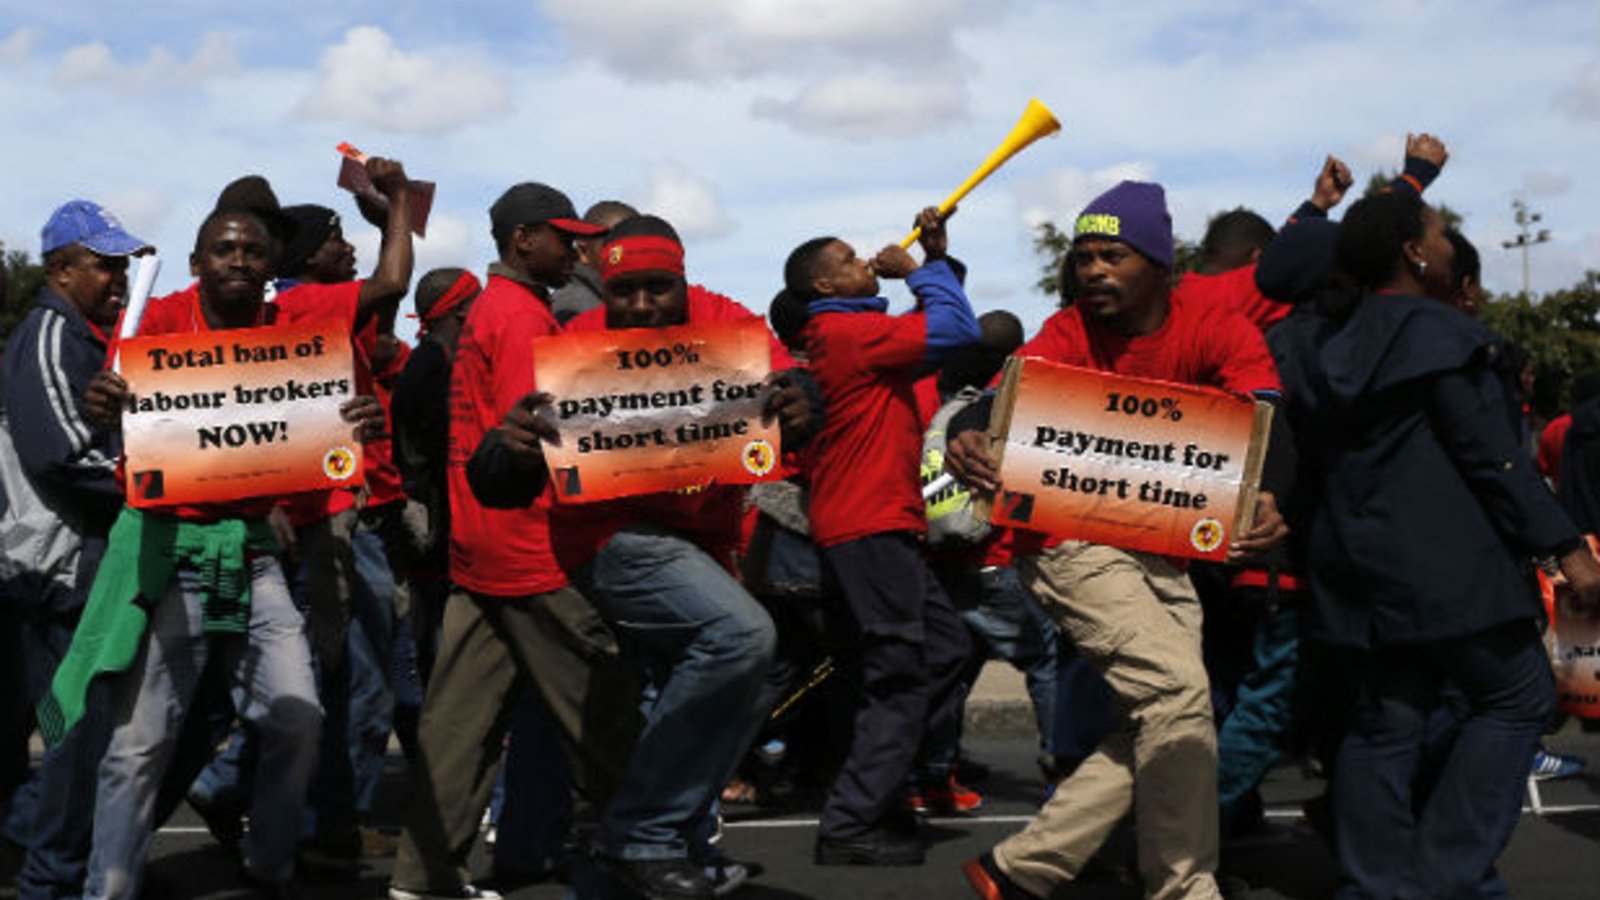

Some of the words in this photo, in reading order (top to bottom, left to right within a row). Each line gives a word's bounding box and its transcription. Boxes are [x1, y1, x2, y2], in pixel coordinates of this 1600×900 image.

[147, 345, 225, 370] Total
[233, 343, 288, 363] ban
[295, 335, 326, 358] of
[616, 343, 700, 370] 100%
[128, 390, 226, 414] labour
[233, 378, 349, 406] brokers
[558, 383, 704, 420] payment
[712, 379, 762, 402] for
[1105, 392, 1183, 422] 100%
[197, 420, 289, 450] NOW!
[577, 427, 666, 453] short
[674, 418, 749, 445] time
[1033, 425, 1176, 463] payment
[1183, 444, 1230, 471] for
[1041, 466, 1131, 500] short
[1138, 480, 1208, 511] time
